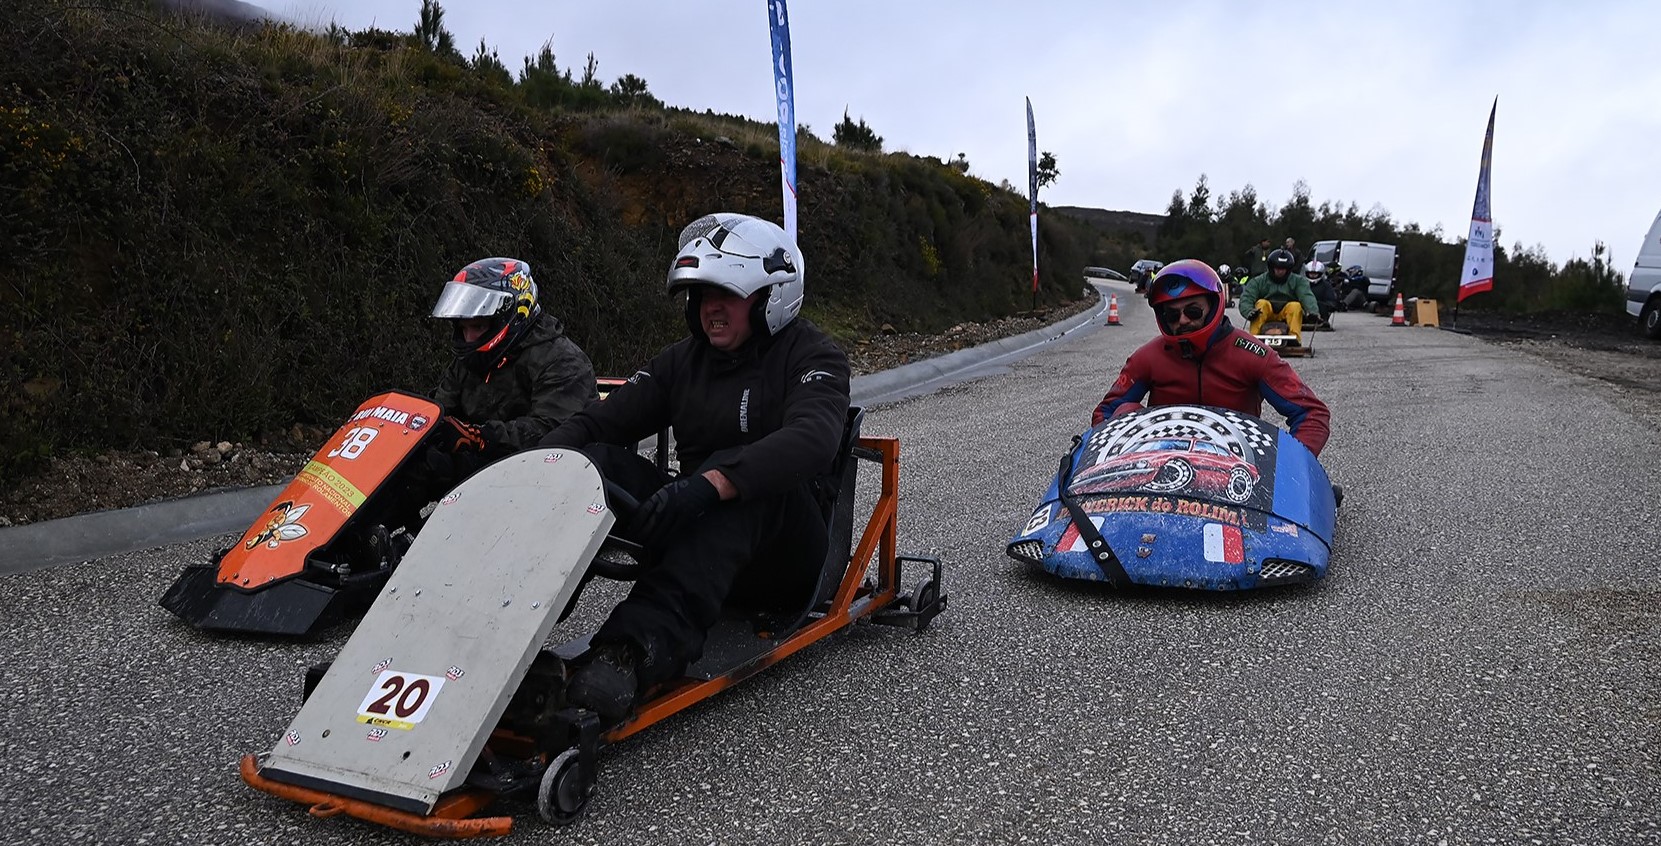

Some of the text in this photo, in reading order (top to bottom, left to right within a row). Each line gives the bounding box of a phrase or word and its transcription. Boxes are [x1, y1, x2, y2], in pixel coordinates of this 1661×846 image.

[370, 406, 409, 425] MAIA
[327, 426, 379, 460] 38
[312, 484, 352, 518] ROLAMENTOS
[321, 484, 351, 510] NACIONAL
[334, 480, 355, 497] 2023
[366, 675, 430, 719] 20
